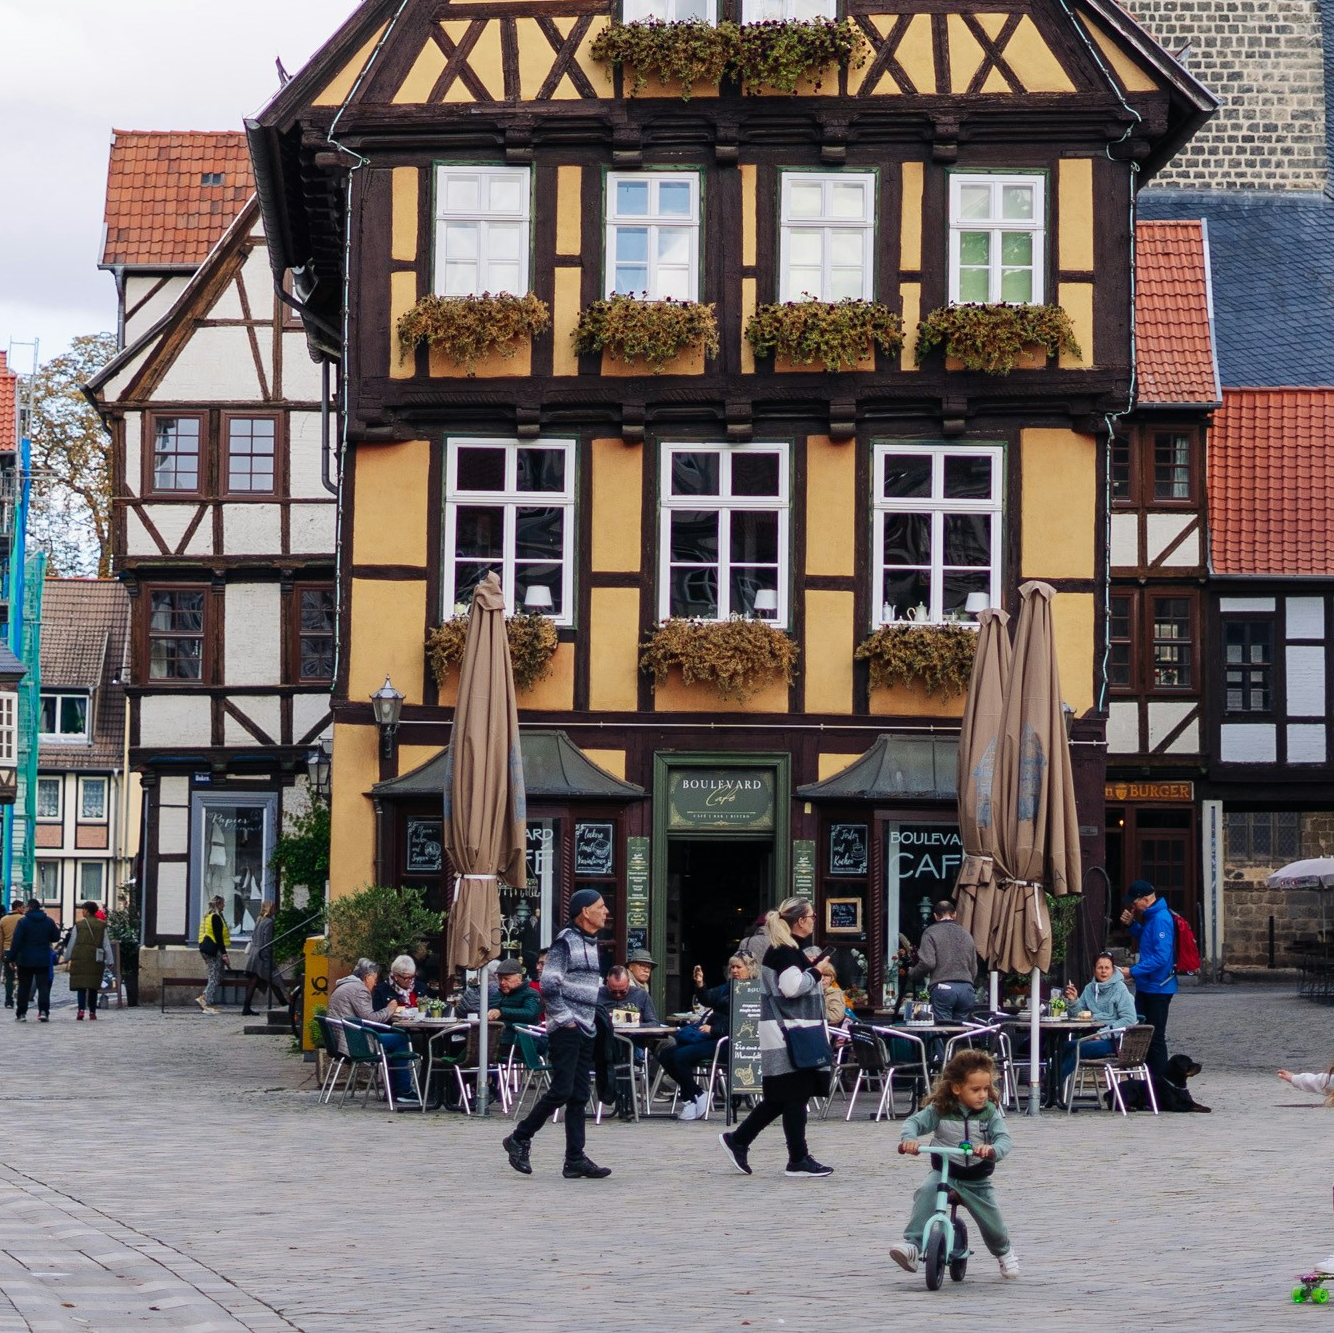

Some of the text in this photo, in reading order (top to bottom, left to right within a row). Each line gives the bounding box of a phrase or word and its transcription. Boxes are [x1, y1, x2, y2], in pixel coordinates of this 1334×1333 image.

[682, 779, 761, 789] BOULEVARD
[1130, 785, 1190, 797] BURGER
[890, 831, 963, 845] BOULEVA
[889, 852, 961, 880] CAF
